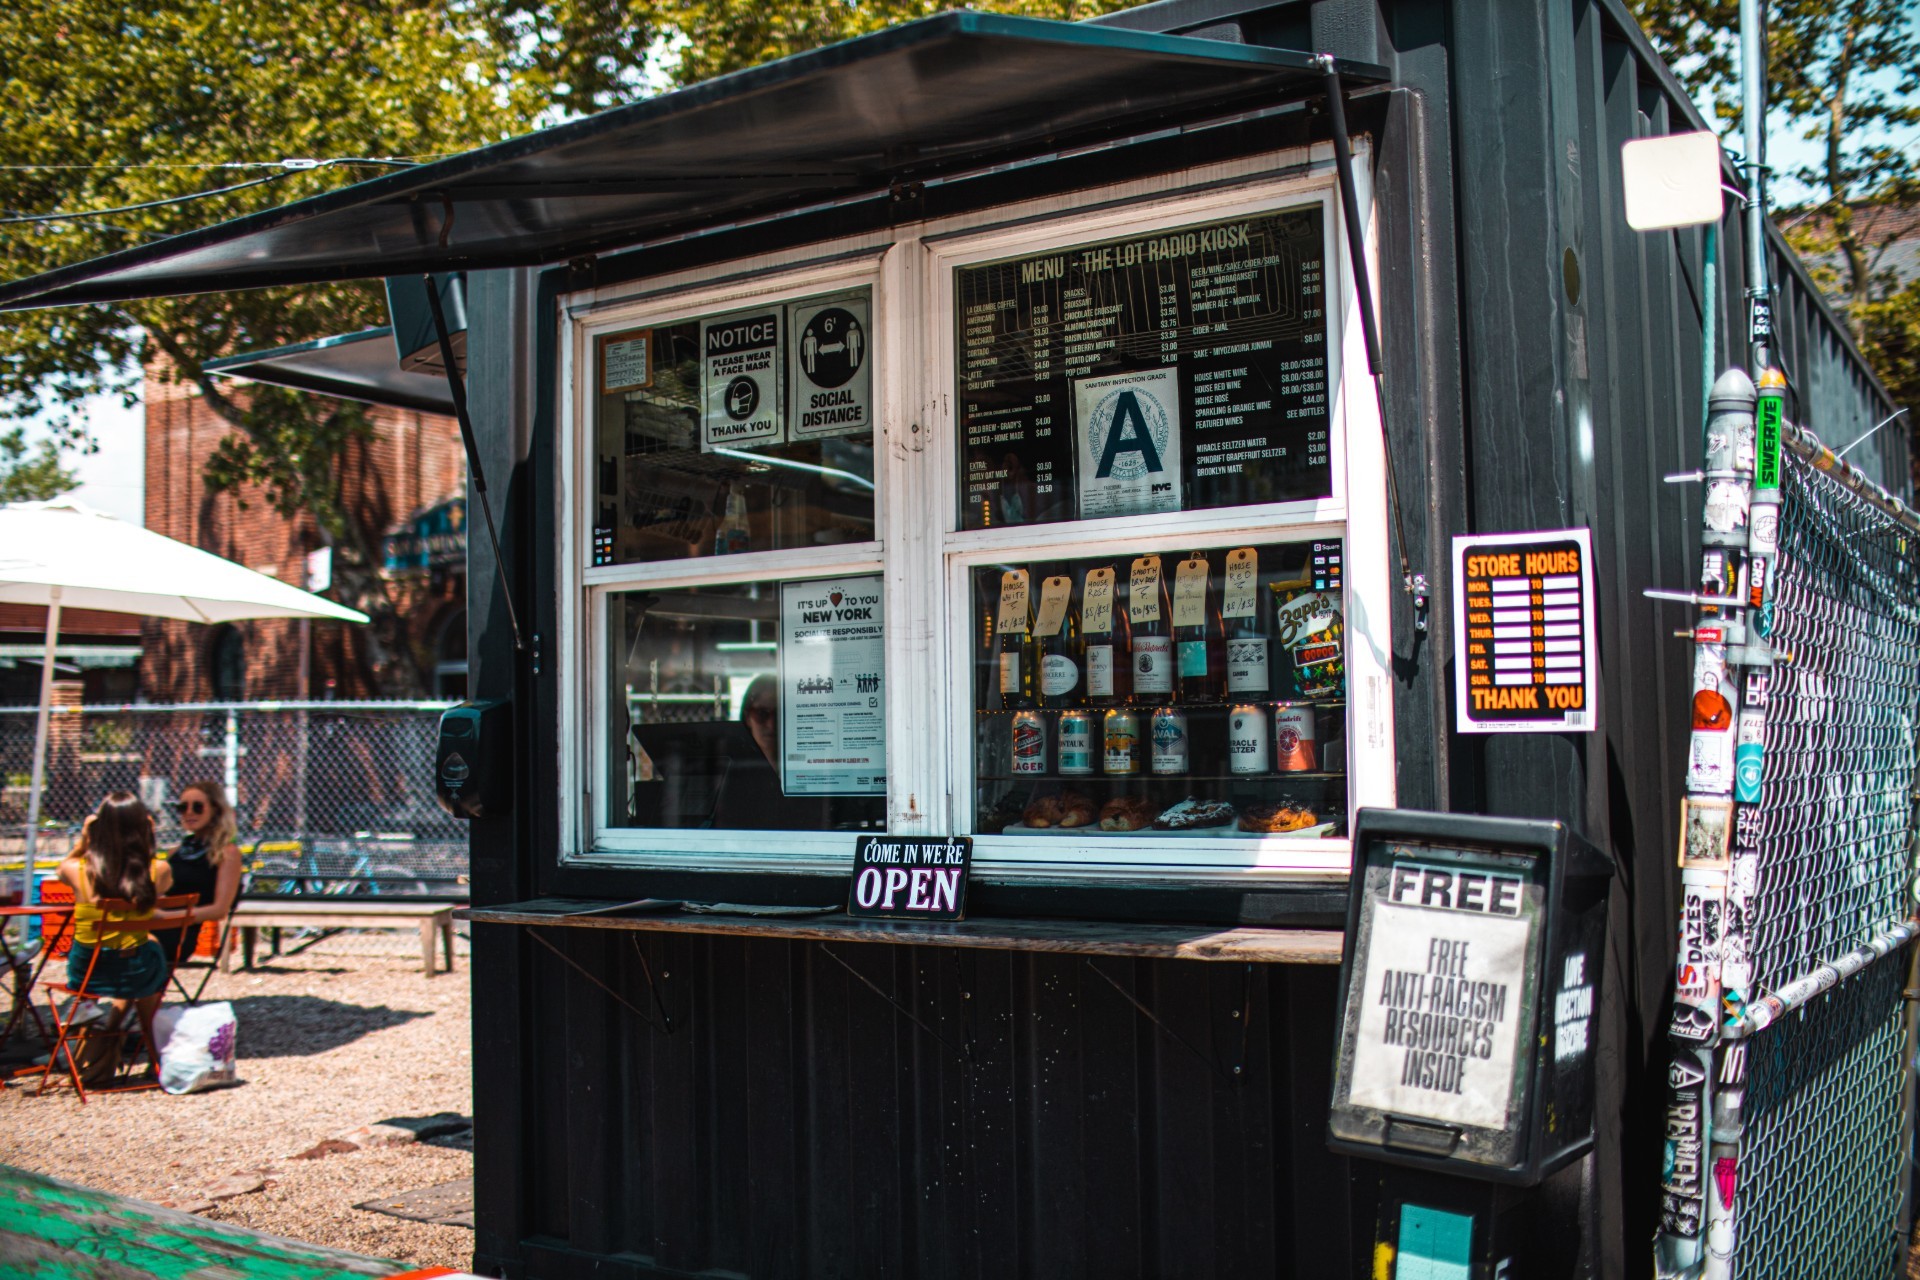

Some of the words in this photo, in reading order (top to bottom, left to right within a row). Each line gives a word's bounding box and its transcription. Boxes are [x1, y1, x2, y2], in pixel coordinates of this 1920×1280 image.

[1022, 257, 1064, 284] MENU
[1082, 249, 1112, 272] THE
[1117, 242, 1144, 267] LOT
[1149, 233, 1196, 261] RADIO
[1201, 224, 1249, 252] KIOSK
[1192, 279, 1209, 288] LAGER
[1192, 301, 1216, 311] SUMMER
[1218, 299, 1228, 307] ALE
[1233, 294, 1260, 305] MONTAUK
[708, 322, 774, 350] NOTICE
[1193, 326, 1209, 335] CIDER
[1065, 343, 1094, 354] BLUEBERRY
[1096, 340, 1115, 349] MUFFIN
[1066, 356, 1084, 366] POTATO
[1086, 354, 1100, 362] CHIPS
[1161, 342, 1177, 352] $3.00
[1194, 349, 1208, 358] SAKE
[712, 355, 744, 368] PLEASE
[746, 351, 771, 362] WEAR
[714, 368, 719, 376] A
[721, 365, 743, 375] FACE
[746, 360, 770, 371] MASK
[1066, 368, 1076, 377] POP
[1077, 366, 1090, 375] CORN
[1195, 372, 1212, 382] HOUSE
[1214, 370, 1231, 379] WHITE
[1233, 367, 1247, 376] WINE
[981, 380, 995, 388] LATTE
[1085, 381, 1111, 389] SANITARY
[1113, 377, 1145, 385] INSPECTION
[1195, 384, 1213, 393] HOUSE
[1214, 382, 1225, 391] RED
[1226, 380, 1241, 390] WINE
[810, 390, 855, 409] SOCIAL
[1195, 396, 1213, 405] HOUSE
[968, 404, 977, 412] TEA
[1196, 406, 1226, 417] SPARKLING
[1232, 403, 1255, 413] ORANGE
[1256, 401, 1271, 410] WINE
[802, 406, 862, 427] DISTANCE
[1196, 419, 1223, 429] FEATURED
[1225, 416, 1243, 426] WINES
[1287, 410, 1298, 419] SEE
[1299, 406, 1325, 417] BOTTLES
[712, 422, 747, 437] THANK
[750, 420, 771, 432] YOU
[969, 426, 981, 434] COLD
[982, 424, 996, 432] BREW
[1036, 417, 1051, 426] $4.00
[969, 437, 980, 445] ICED
[981, 436, 990, 444] TEA
[995, 434, 1008, 442] HOME
[1010, 431, 1024, 440] MADE
[1036, 428, 1051, 437] $4.00
[1095, 391, 1163, 478] A
[1197, 443, 1220, 452] MIRACLE
[1222, 440, 1246, 450] SELTZER
[1247, 438, 1266, 447] WATER
[1308, 431, 1326, 441] $2.00
[1762, 400, 1776, 485] SWERVE
[1197, 454, 1225, 464] SPINDRIFT
[1226, 450, 1260, 461] GRAPEFRUIT
[1262, 448, 1286, 458] SELTZER
[1308, 444, 1326, 453] $3.00
[1197, 466, 1226, 476] BROOKLYN
[1227, 464, 1242, 473] MATE
[970, 483, 986, 492] EXTRA
[987, 482, 1000, 490] SHOT
[1152, 483, 1171, 492] NYC
[1230, 562, 1251, 571] HOUSE
[1468, 554, 1521, 577] STORE
[1526, 551, 1579, 574] HOURS
[1004, 582, 1024, 591] HOUSE
[1468, 581, 1489, 592] MON.
[1531, 578, 1542, 588] TO
[1750, 559, 1765, 608] CRONY
[798, 600, 813, 609] IT'S
[816, 600, 827, 608] UP
[859, 596, 878, 604] YOU
[1469, 597, 1492, 607] TUES.
[1532, 595, 1542, 605] TO
[803, 610, 832, 623] NEW
[835, 608, 872, 621] YORK
[1470, 613, 1491, 623] WED.
[1532, 610, 1543, 620] TO
[833, 626, 883, 635] RESPONSIBLY
[1470, 628, 1493, 638] THUR.
[1533, 626, 1543, 636] TO
[1470, 643, 1486, 654] FRI.
[1533, 641, 1544, 652] TO
[1471, 659, 1488, 669] SAT.
[1534, 657, 1544, 667] TO
[1471, 674, 1490, 685] SUN.
[1534, 673, 1544, 682] TO
[1472, 687, 1539, 710] THANK
[1544, 686, 1583, 708] YOU
[1277, 716, 1301, 724] pindrift
[1153, 729, 1177, 738] AVAL
[864, 844, 900, 863] COME
[903, 845, 918, 863] IN
[922, 845, 964, 864] WE'RE
[857, 867, 961, 911] OPEN
[1393, 866, 1520, 916] FREE
[1686, 894, 1702, 964] DAZES
[1428, 938, 1469, 978] FREE
[1379, 970, 1507, 1022] ANTI-RACISM
[1383, 1007, 1495, 1060] RESOURCES
[1401, 1048, 1465, 1095] INSIDE
